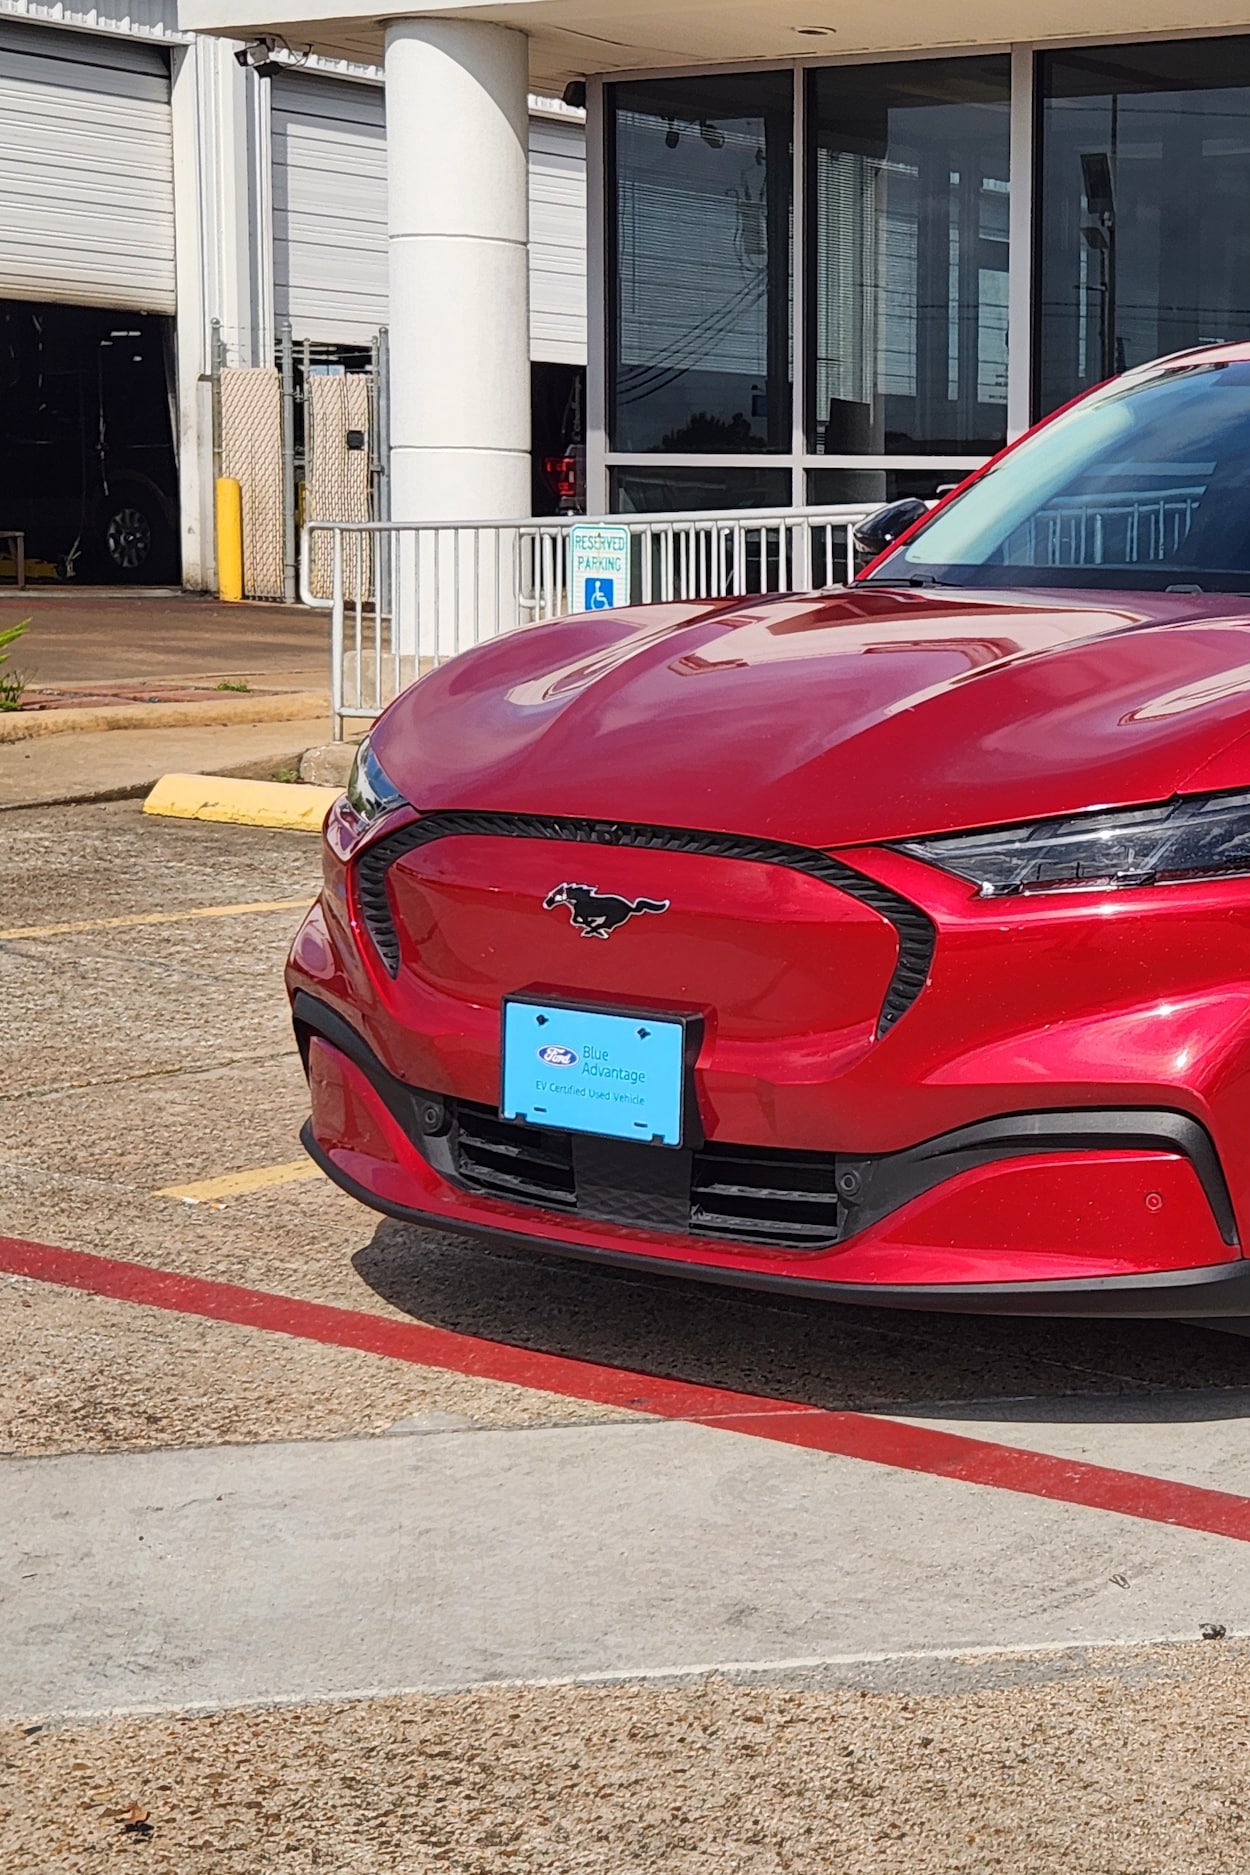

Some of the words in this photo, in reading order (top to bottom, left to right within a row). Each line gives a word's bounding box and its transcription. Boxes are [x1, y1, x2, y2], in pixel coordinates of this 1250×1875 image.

[575, 535, 625, 551] RESERVED
[577, 556, 621, 572] PARKING
[583, 1046, 609, 1061] Blue
[582, 1062, 646, 1084] Advantage
[535, 1081, 547, 1091] EV
[549, 1082, 586, 1097] Certified
[588, 1089, 610, 1101] Used
[613, 1092, 645, 1105] Vehicle
